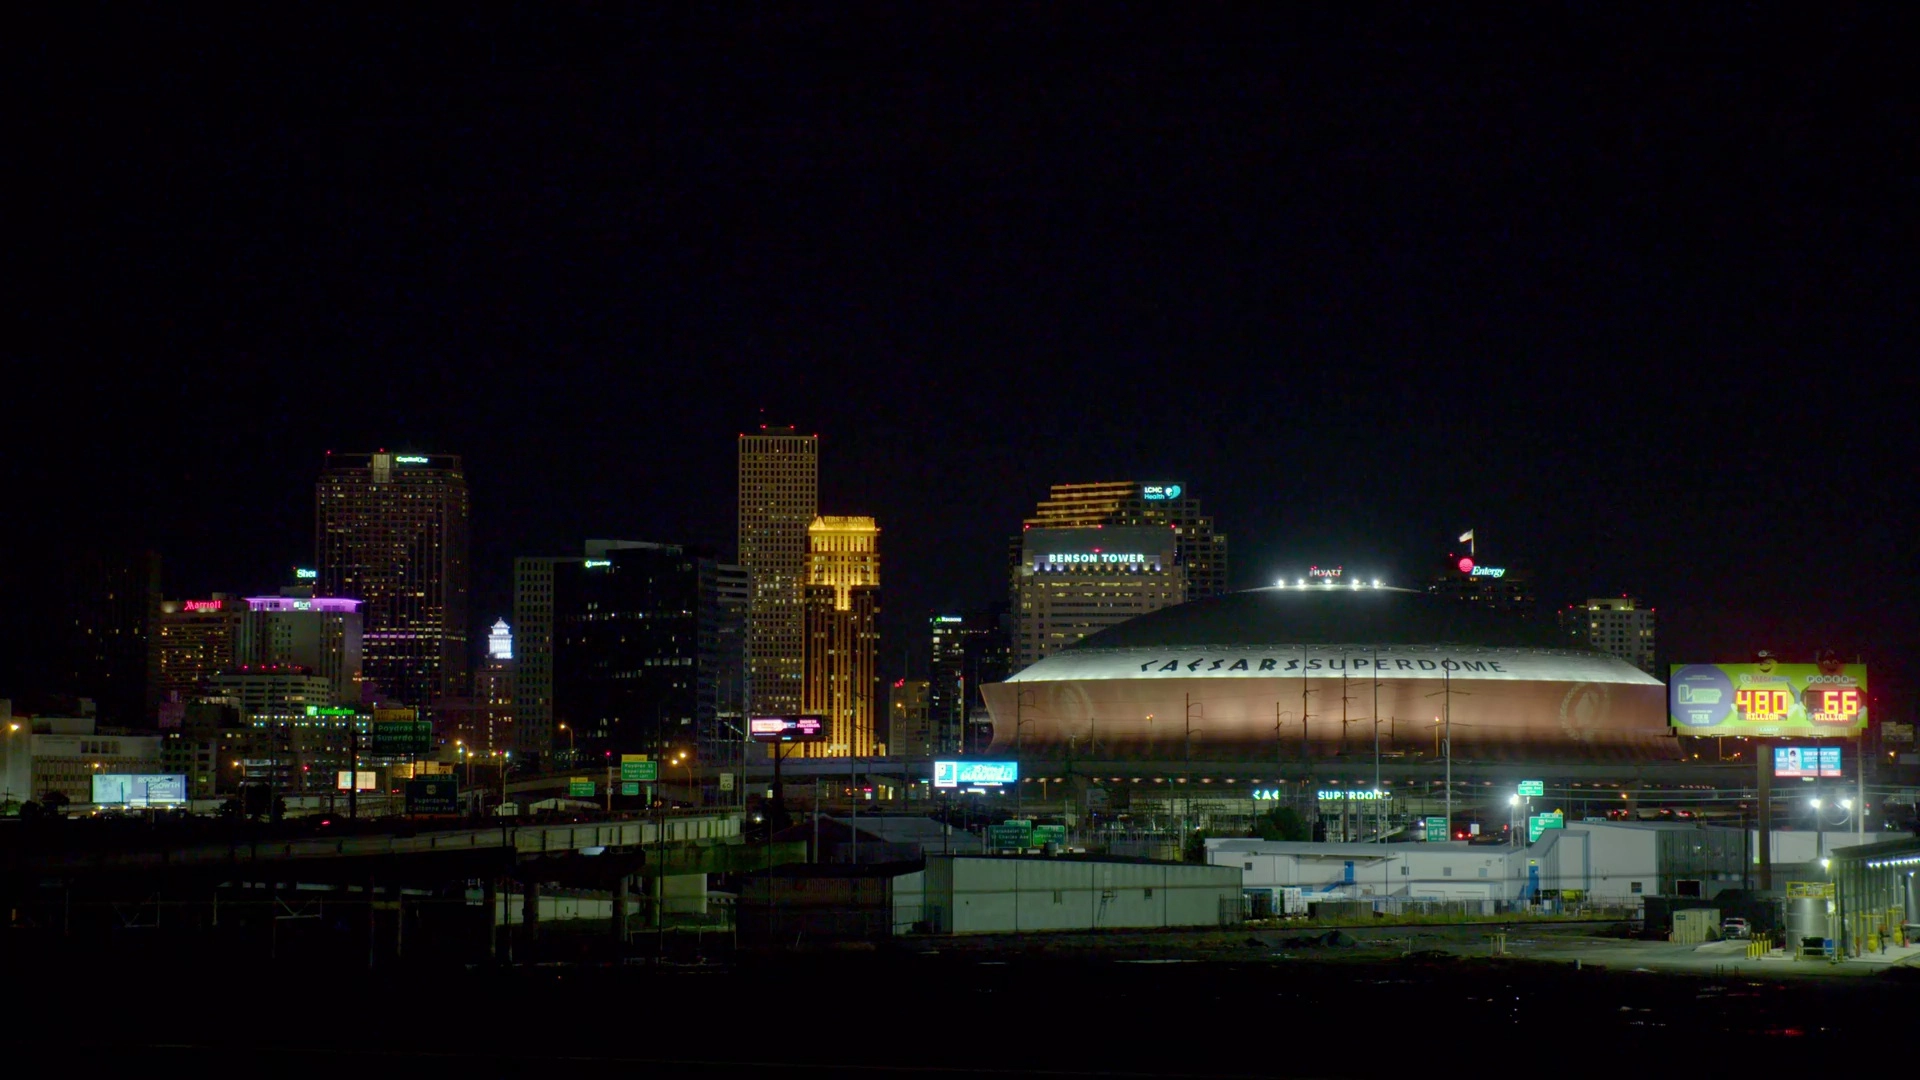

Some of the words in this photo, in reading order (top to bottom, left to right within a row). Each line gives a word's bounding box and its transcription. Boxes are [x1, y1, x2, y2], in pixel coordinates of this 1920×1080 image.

[1143, 486, 1162, 494] LCMC
[1048, 554, 1098, 563] BENSON
[1101, 554, 1145, 563] TOWER
[1313, 569, 1342, 577] HYATT
[1472, 565, 1505, 578] Entergy
[183, 600, 222, 611] Marriott
[1141, 657, 1300, 673] CAESARS
[1304, 657, 1508, 673] SUPERDOME
[1807, 676, 1849, 684] POWER
[1736, 691, 1788, 714] 480
[1823, 691, 1857, 714] 66
[319, 707, 343, 716] Holiday
[1745, 712, 1779, 720] MILLION
[1814, 713, 1848, 721] MILLION
[378, 725, 413, 733] Poydras
[377, 734, 426, 742] Superdoe
